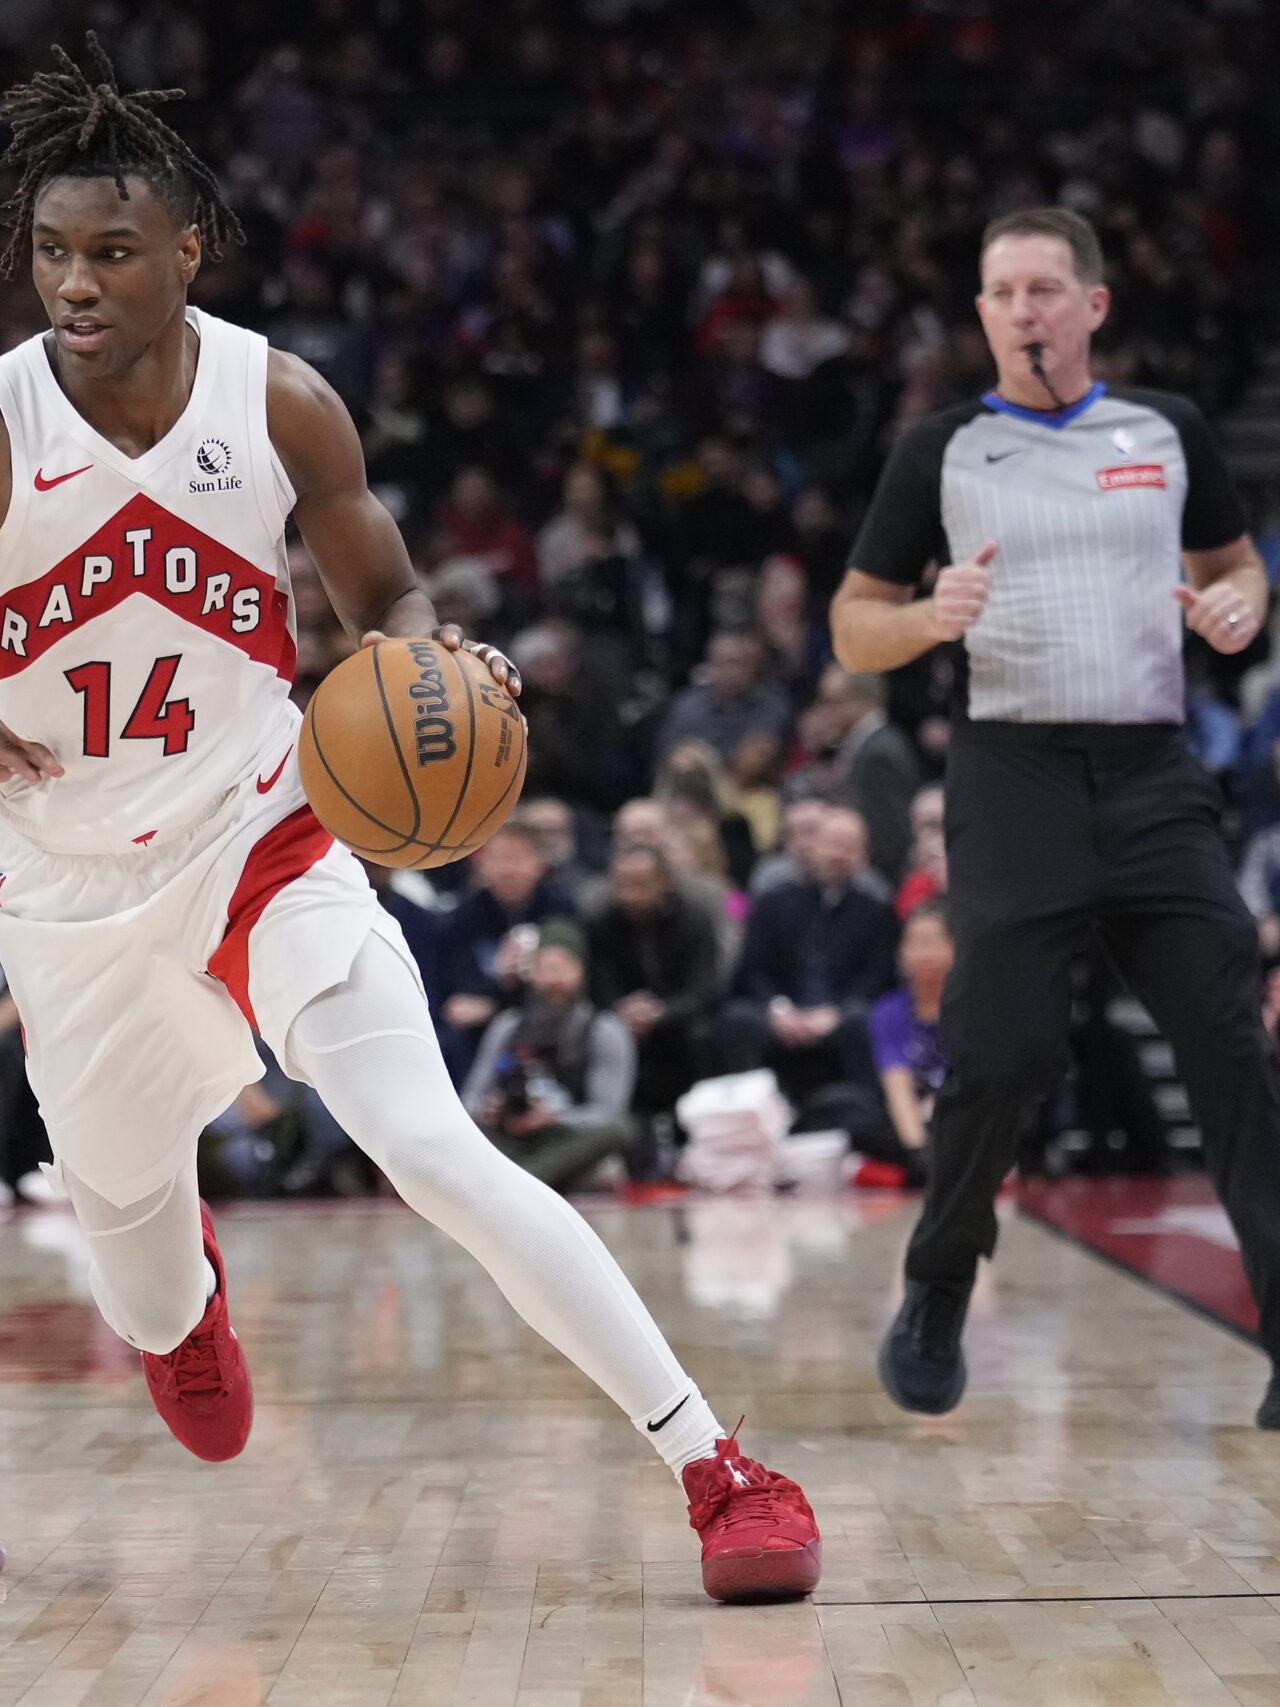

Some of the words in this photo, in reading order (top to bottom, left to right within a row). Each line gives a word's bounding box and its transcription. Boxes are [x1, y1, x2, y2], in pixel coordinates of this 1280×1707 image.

[189, 480, 215, 493] Sun
[217, 475, 242, 491] Life
[0, 527, 261, 658] RAPTORS
[62, 653, 195, 758] 14
[406, 641, 457, 768] Wilson
